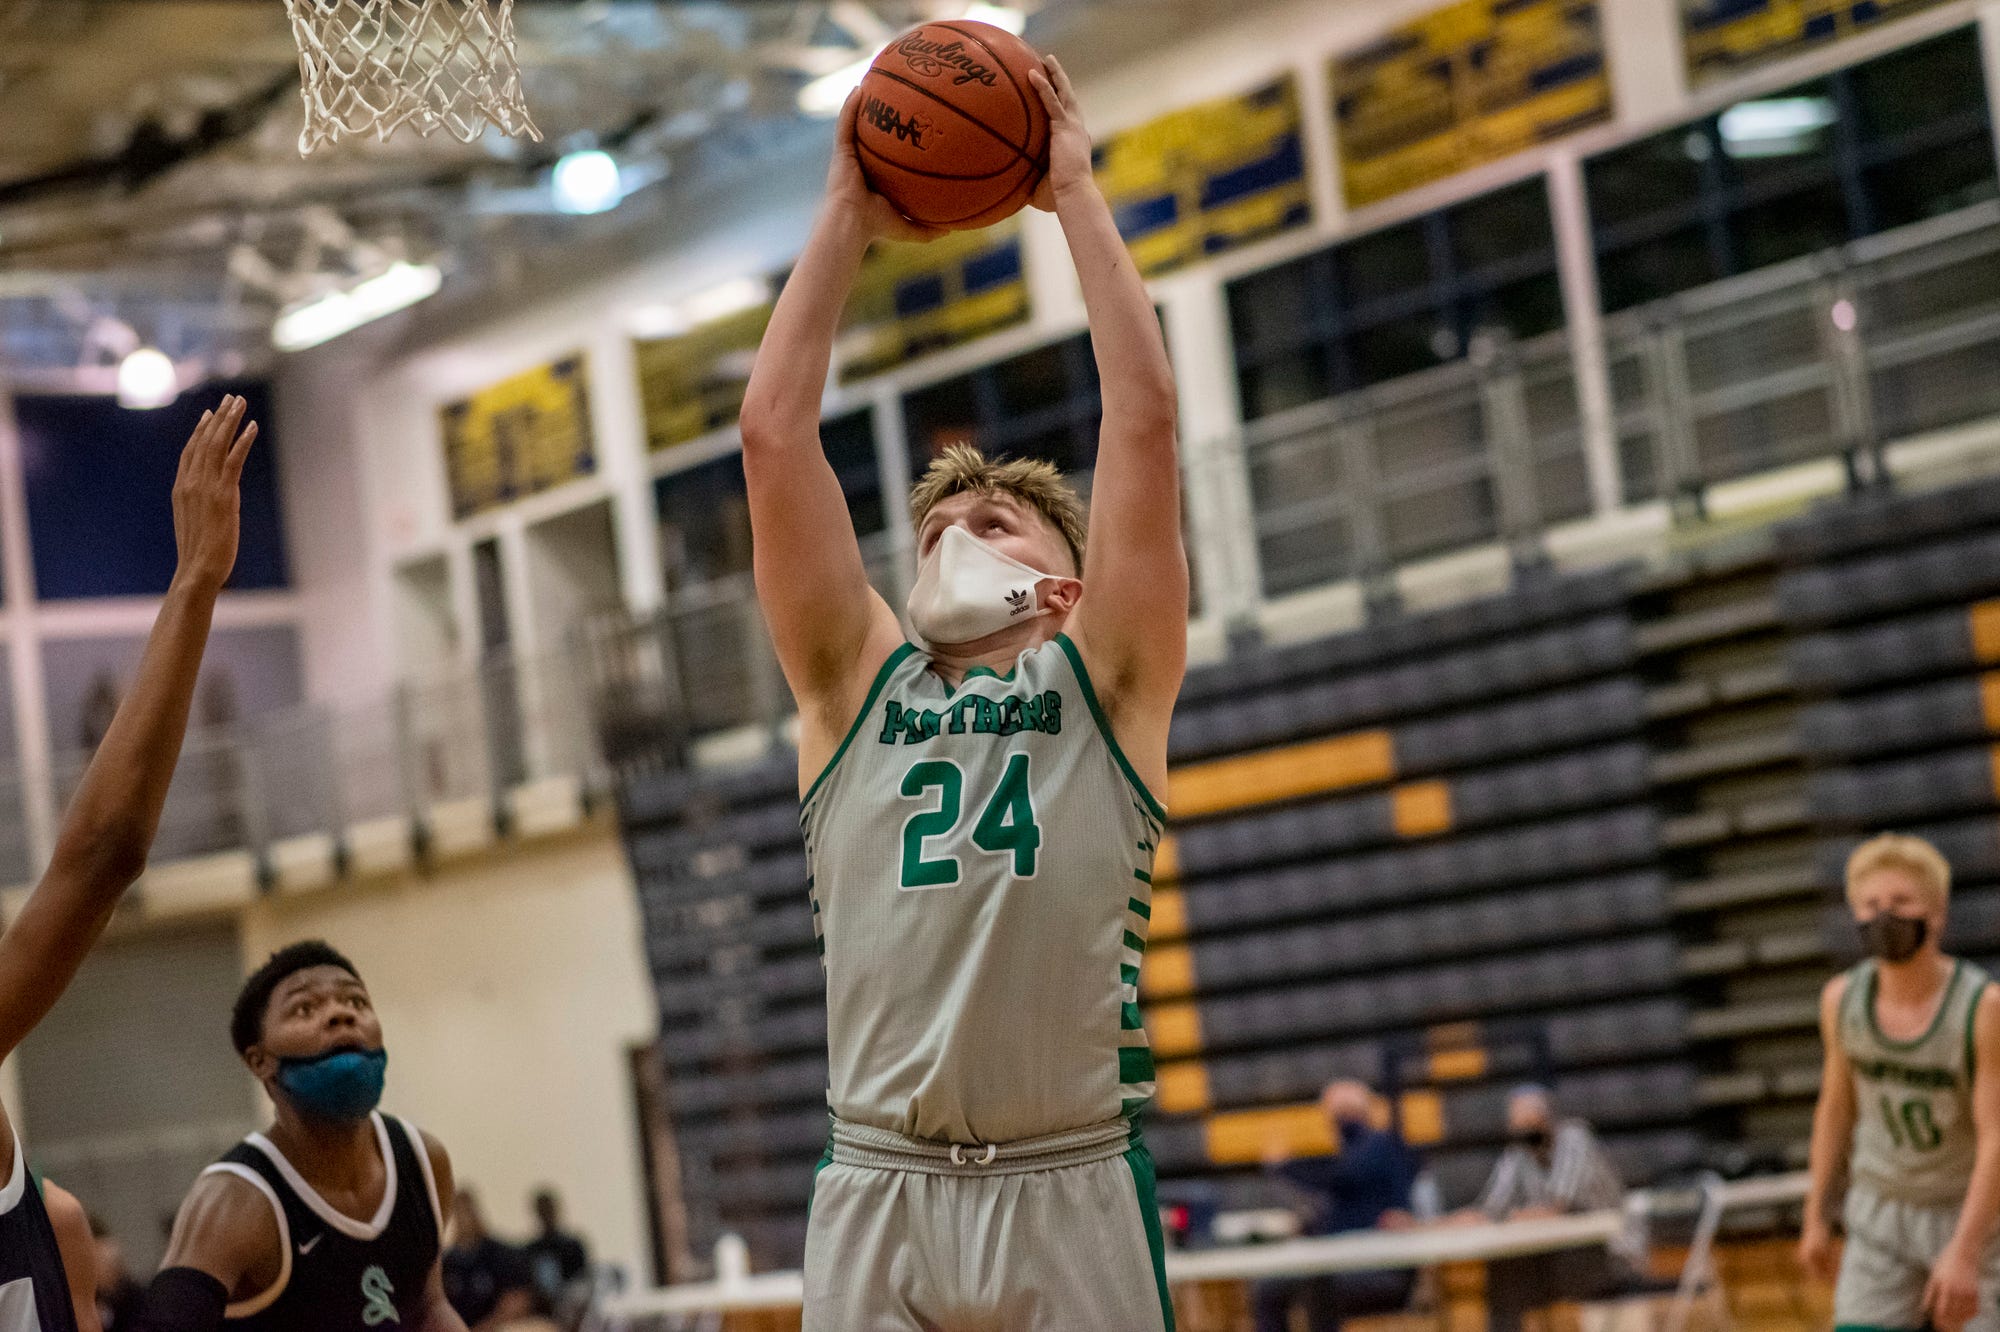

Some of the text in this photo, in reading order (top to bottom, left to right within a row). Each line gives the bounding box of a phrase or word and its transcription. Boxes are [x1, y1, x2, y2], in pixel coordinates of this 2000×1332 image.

[885, 31, 998, 87] Rawlings
[1010, 604, 1030, 616] adidas
[898, 751, 1043, 892] 24
[1879, 1093, 1941, 1153] 10
